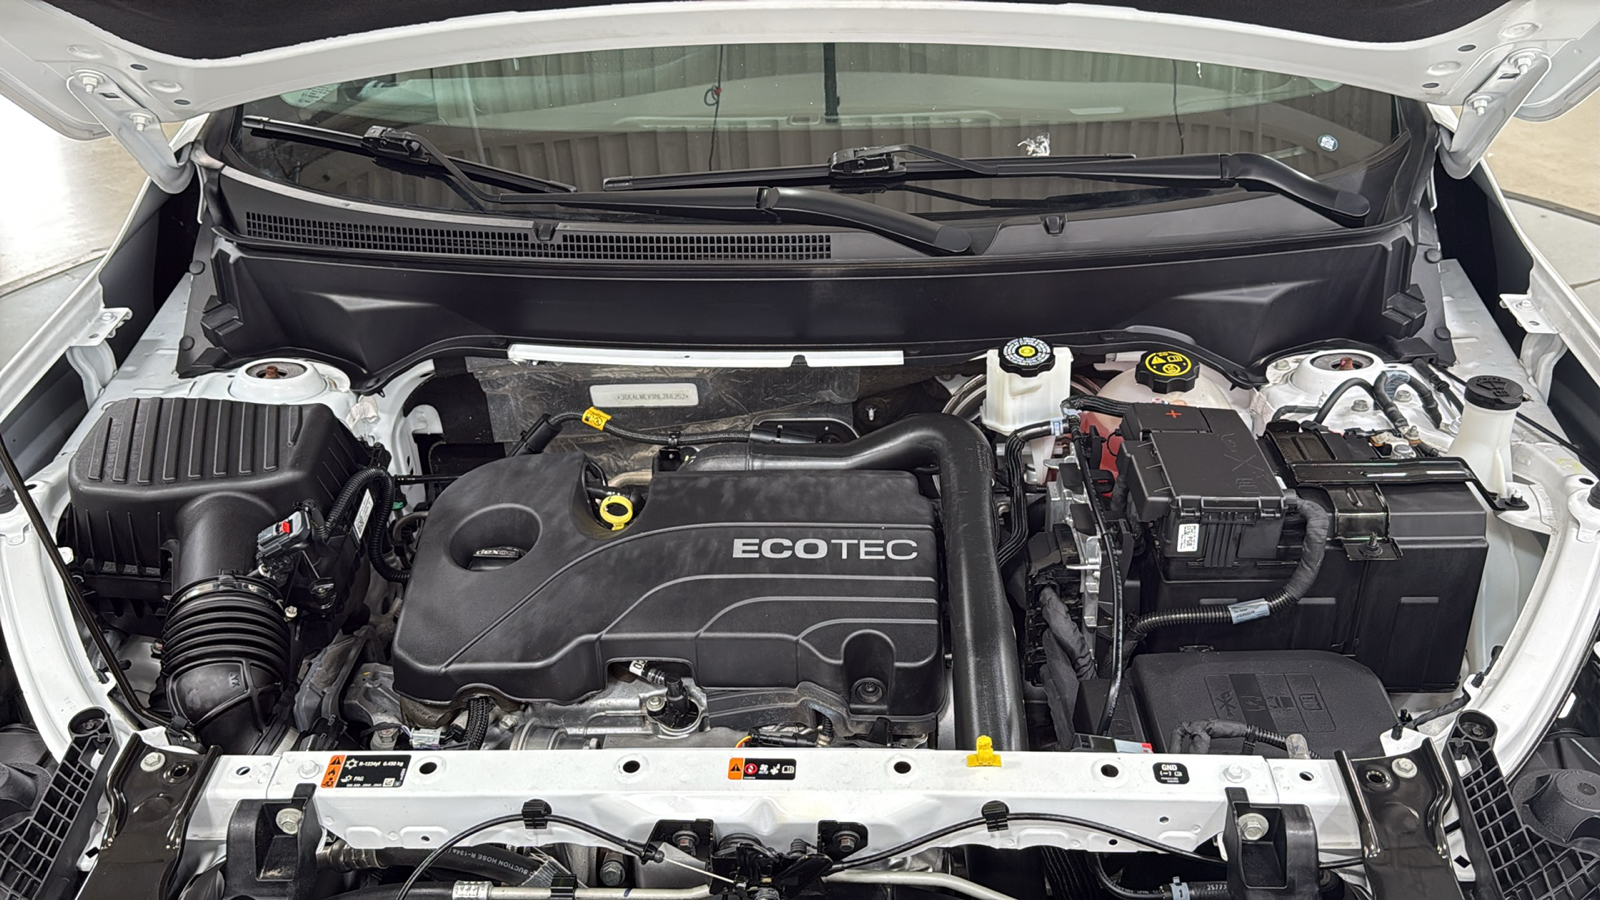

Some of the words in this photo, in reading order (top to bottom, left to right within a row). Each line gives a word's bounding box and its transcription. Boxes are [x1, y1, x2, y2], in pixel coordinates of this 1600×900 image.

[733, 538, 918, 560] ECOTEC
[478, 855, 498, 864] HOSE
[498, 860, 528, 875] SUCTION
